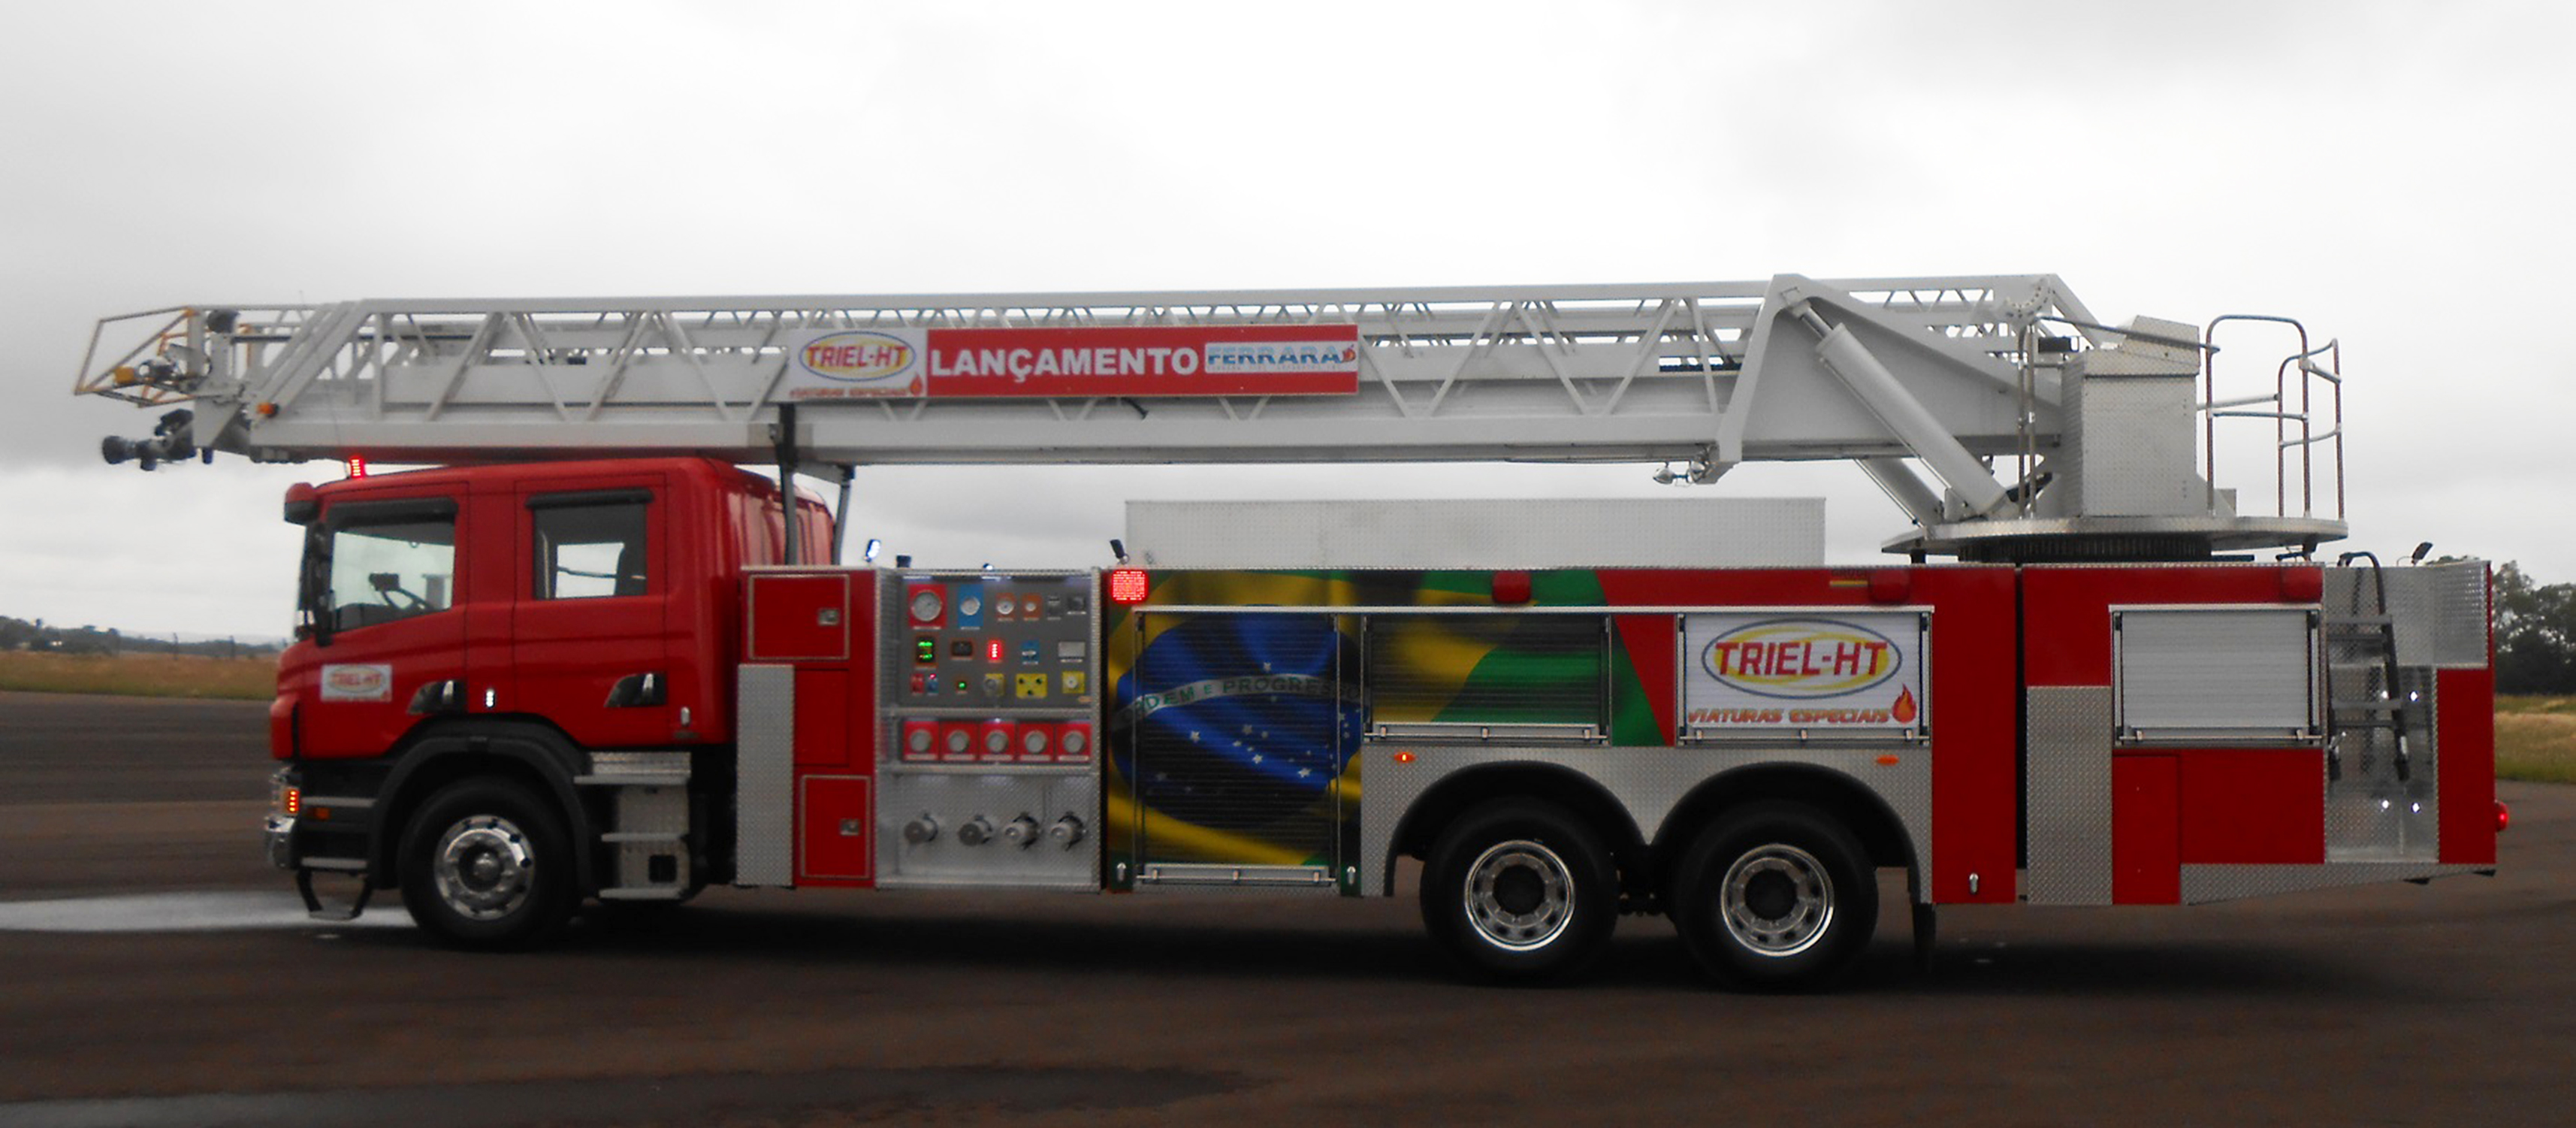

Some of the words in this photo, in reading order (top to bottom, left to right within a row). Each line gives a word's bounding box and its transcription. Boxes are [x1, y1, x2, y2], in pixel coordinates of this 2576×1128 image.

[807, 346, 907, 367] TRIEL-HT
[1207, 346, 1342, 364] FERRARA
[930, 347, 1198, 383] LANÇAMENTO
[1715, 642, 1888, 675] TRIEL-HT
[1203, 685, 1212, 694] E
[1687, 708, 1783, 724] VIATURAS
[1789, 708, 1892, 724] ESPECIAIS
